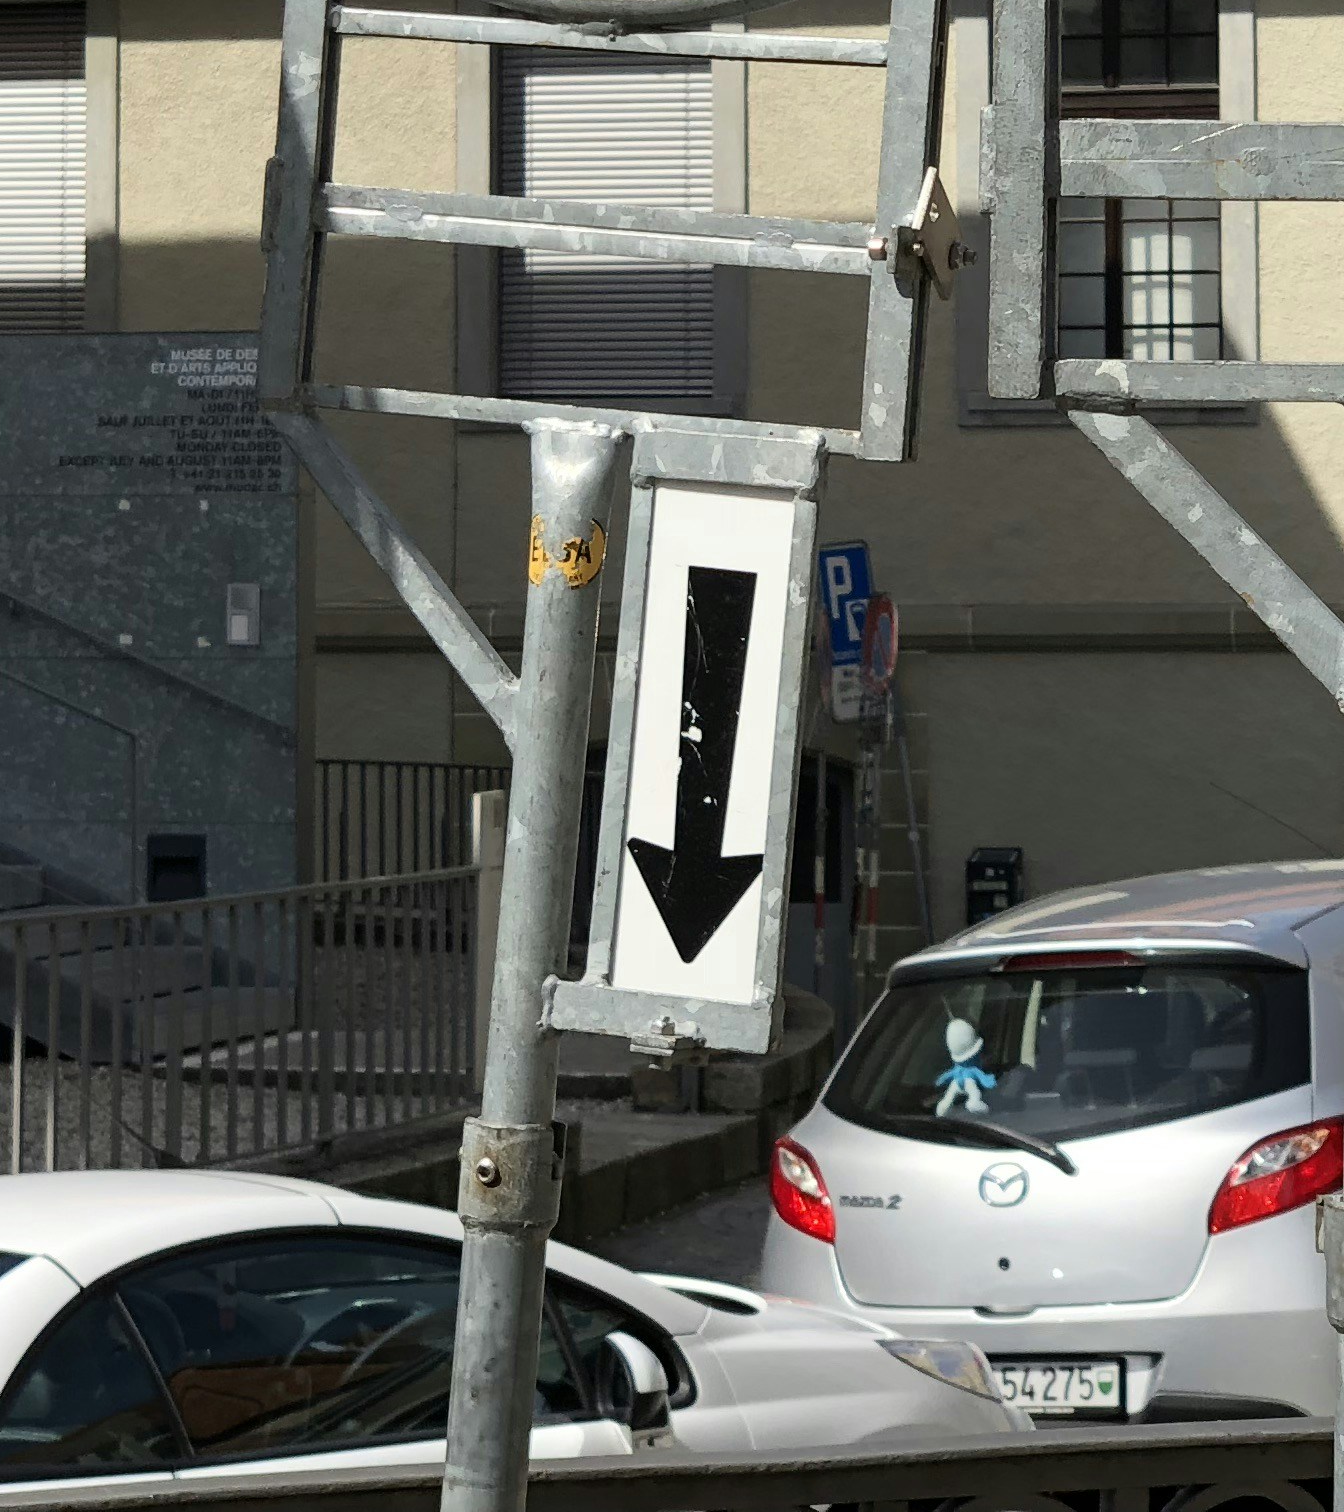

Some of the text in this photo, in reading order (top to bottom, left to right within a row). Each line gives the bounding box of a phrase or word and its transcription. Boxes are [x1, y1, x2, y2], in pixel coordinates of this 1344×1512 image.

[171, 348, 213, 360] MUSÉE
[217, 349, 233, 360] DE
[151, 362, 166, 374] ET
[176, 441, 282, 452] MONDAY CLOSED
[826, 555, 853, 620] P
[885, 1194, 903, 1209] 2
